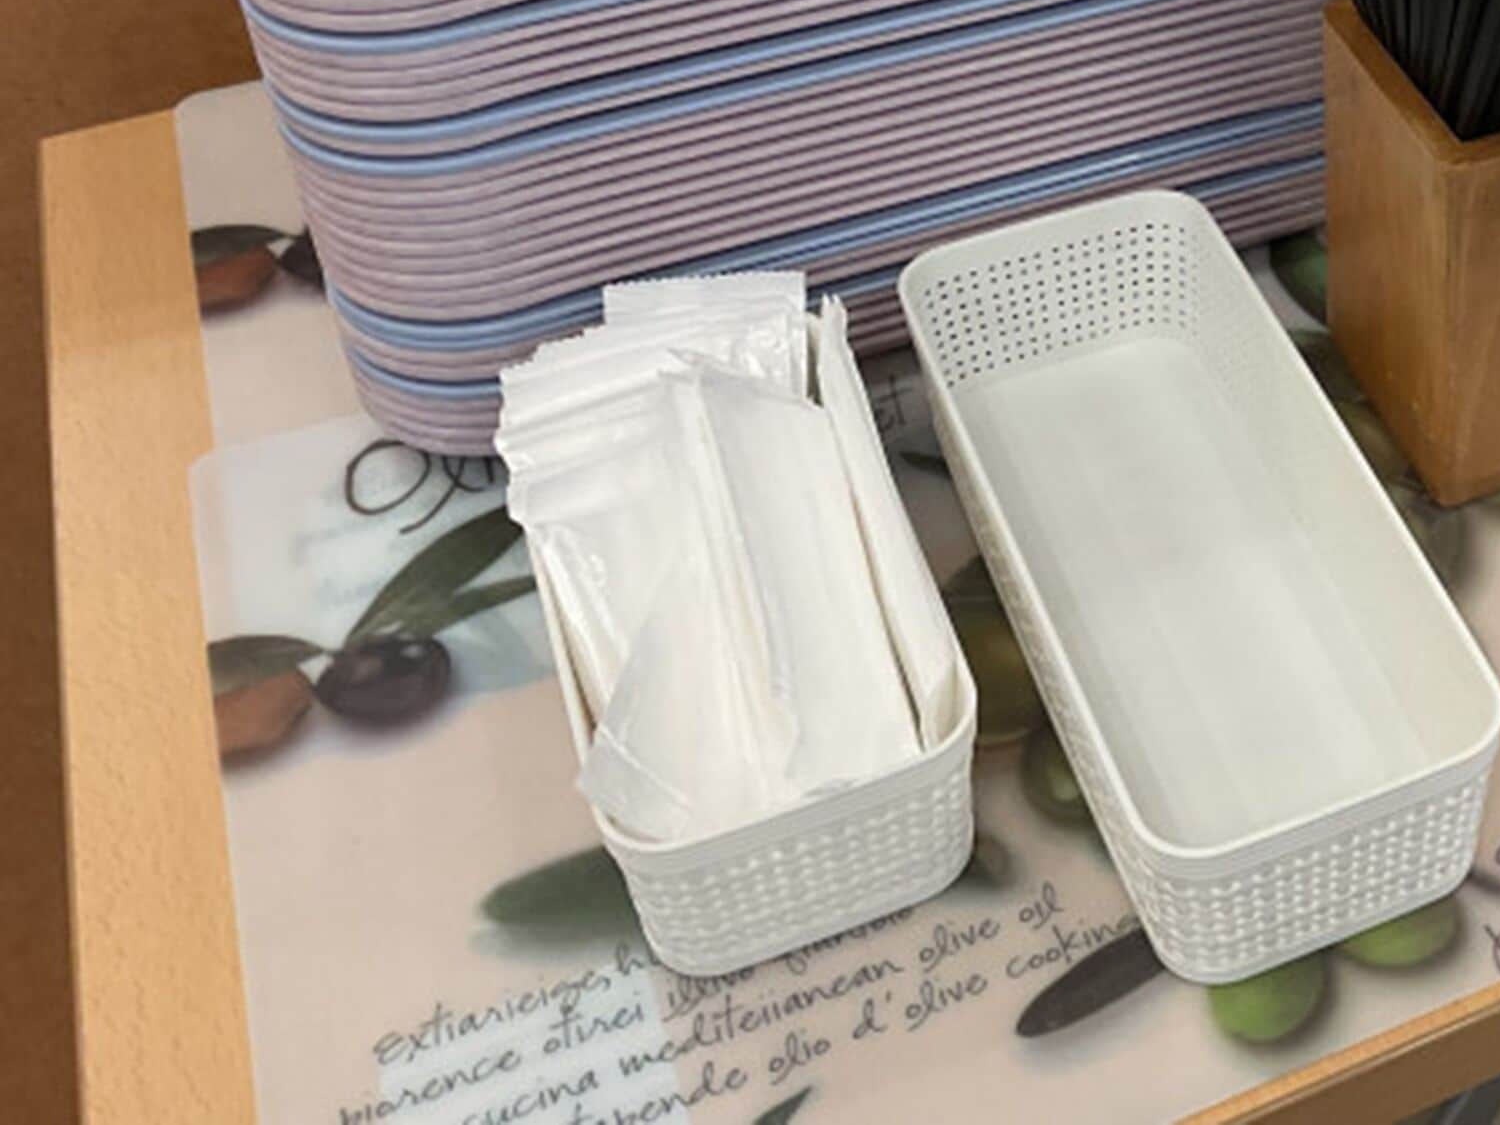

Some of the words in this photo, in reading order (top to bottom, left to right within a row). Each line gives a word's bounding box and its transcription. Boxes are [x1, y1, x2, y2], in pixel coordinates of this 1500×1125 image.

[918, 918, 1001, 973] olive
[1018, 880, 1065, 931] oil
[767, 1028, 831, 1086] olio
[904, 972, 988, 1033] olive
